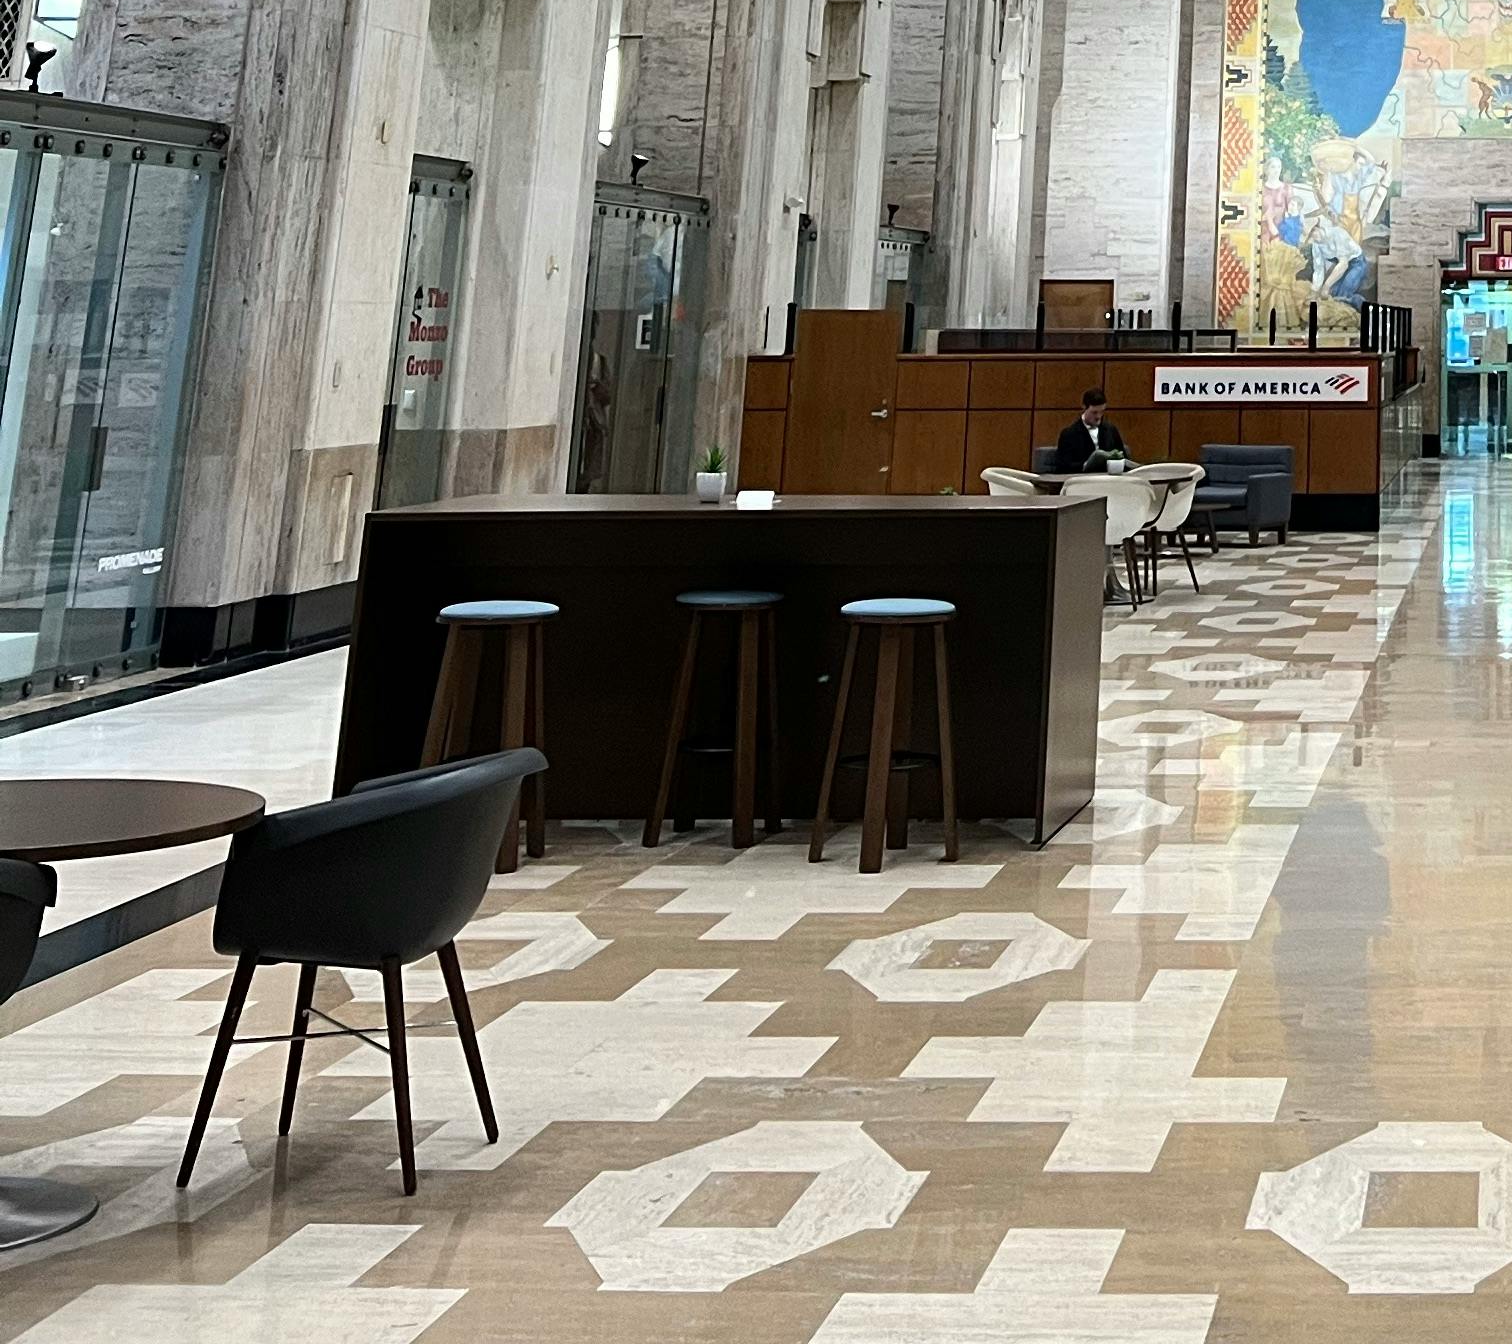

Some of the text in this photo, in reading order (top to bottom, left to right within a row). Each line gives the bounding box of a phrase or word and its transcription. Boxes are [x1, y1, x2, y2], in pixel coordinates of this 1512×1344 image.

[428, 287, 448, 308] The
[406, 355, 443, 381] Group
[1161, 382, 1321, 395] BANK OF AMERICA
[98, 547, 164, 572] PROMENADE
